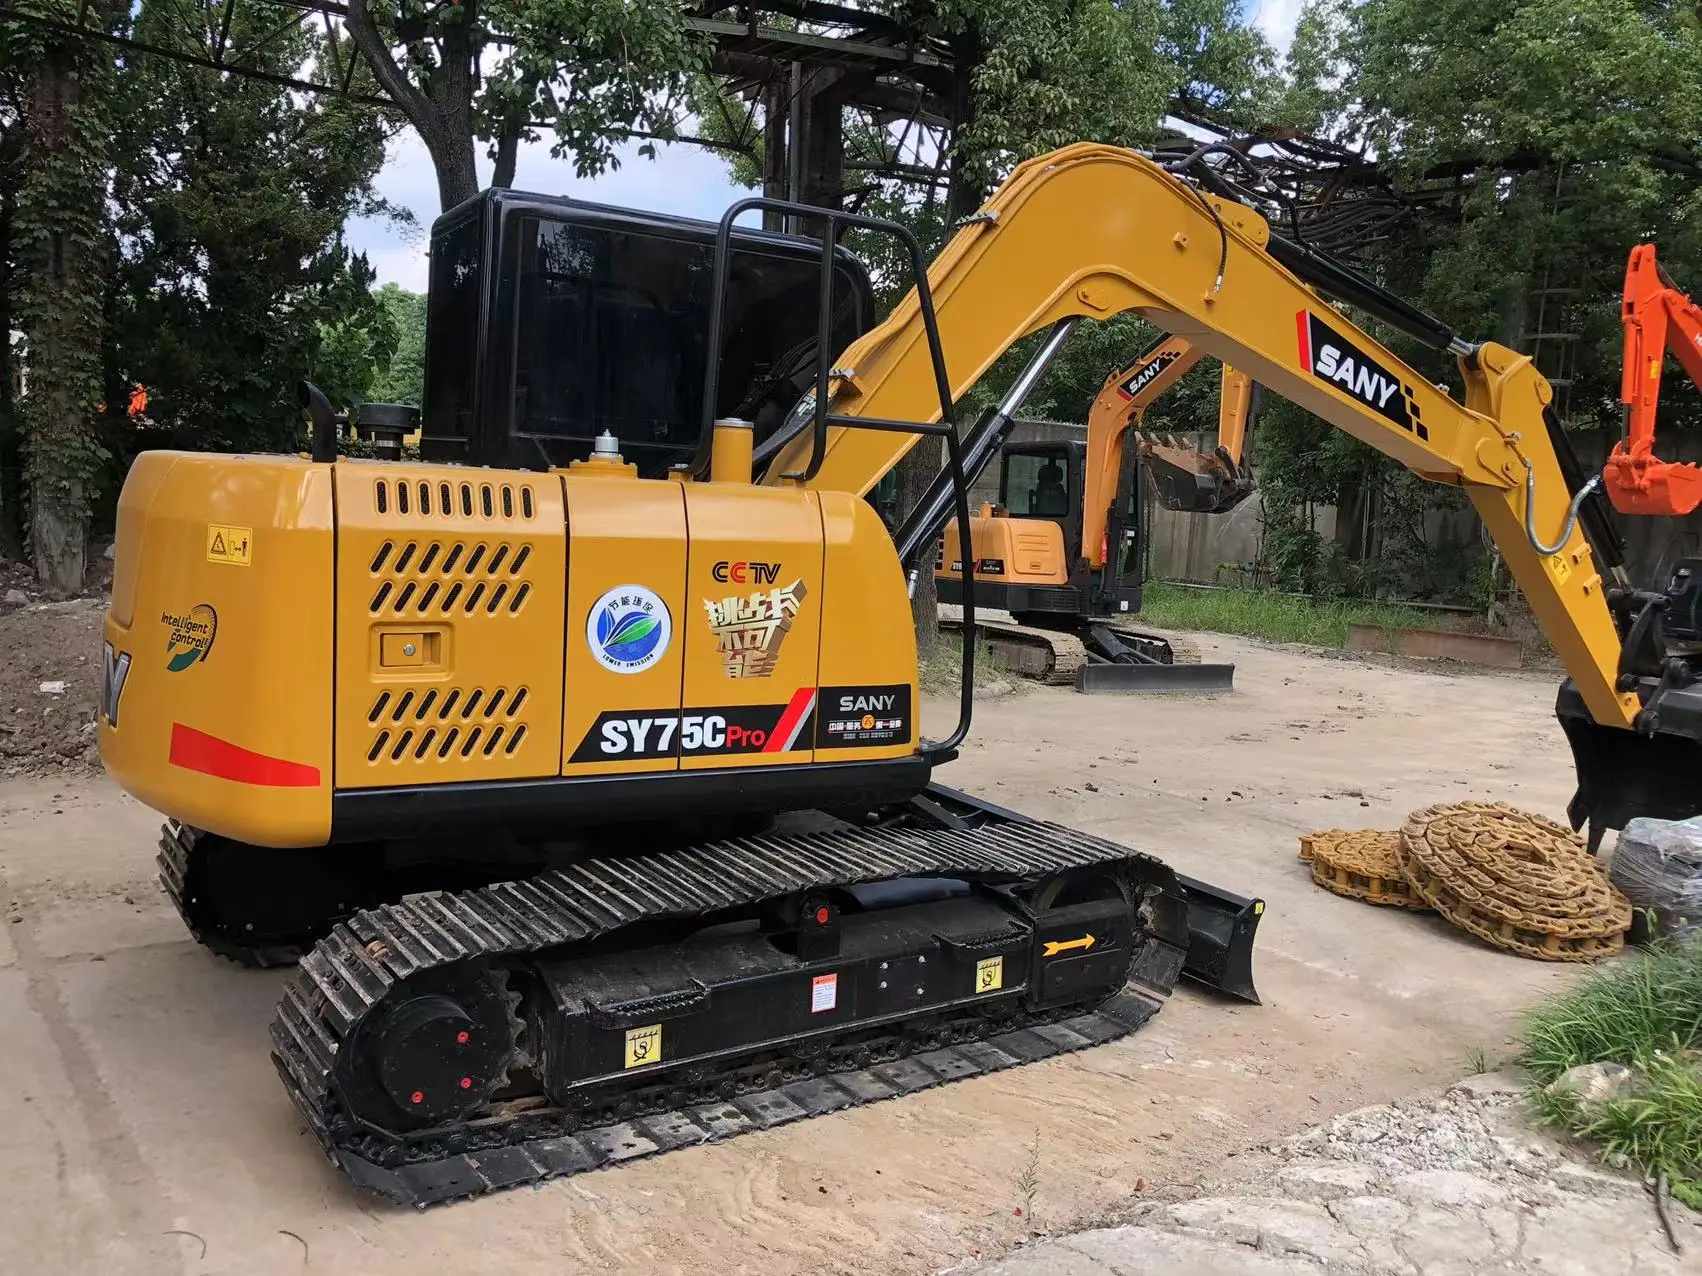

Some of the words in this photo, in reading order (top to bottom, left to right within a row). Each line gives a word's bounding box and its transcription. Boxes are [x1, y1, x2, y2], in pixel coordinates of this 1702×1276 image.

[1129, 359, 1160, 394] SANY
[1316, 344, 1398, 408] SANY
[712, 561, 781, 584] CCTV
[161, 611, 208, 634] Intelligent
[839, 695, 895, 711] SANY
[600, 715, 726, 753] SY75C
[726, 726, 766, 749] Pro
